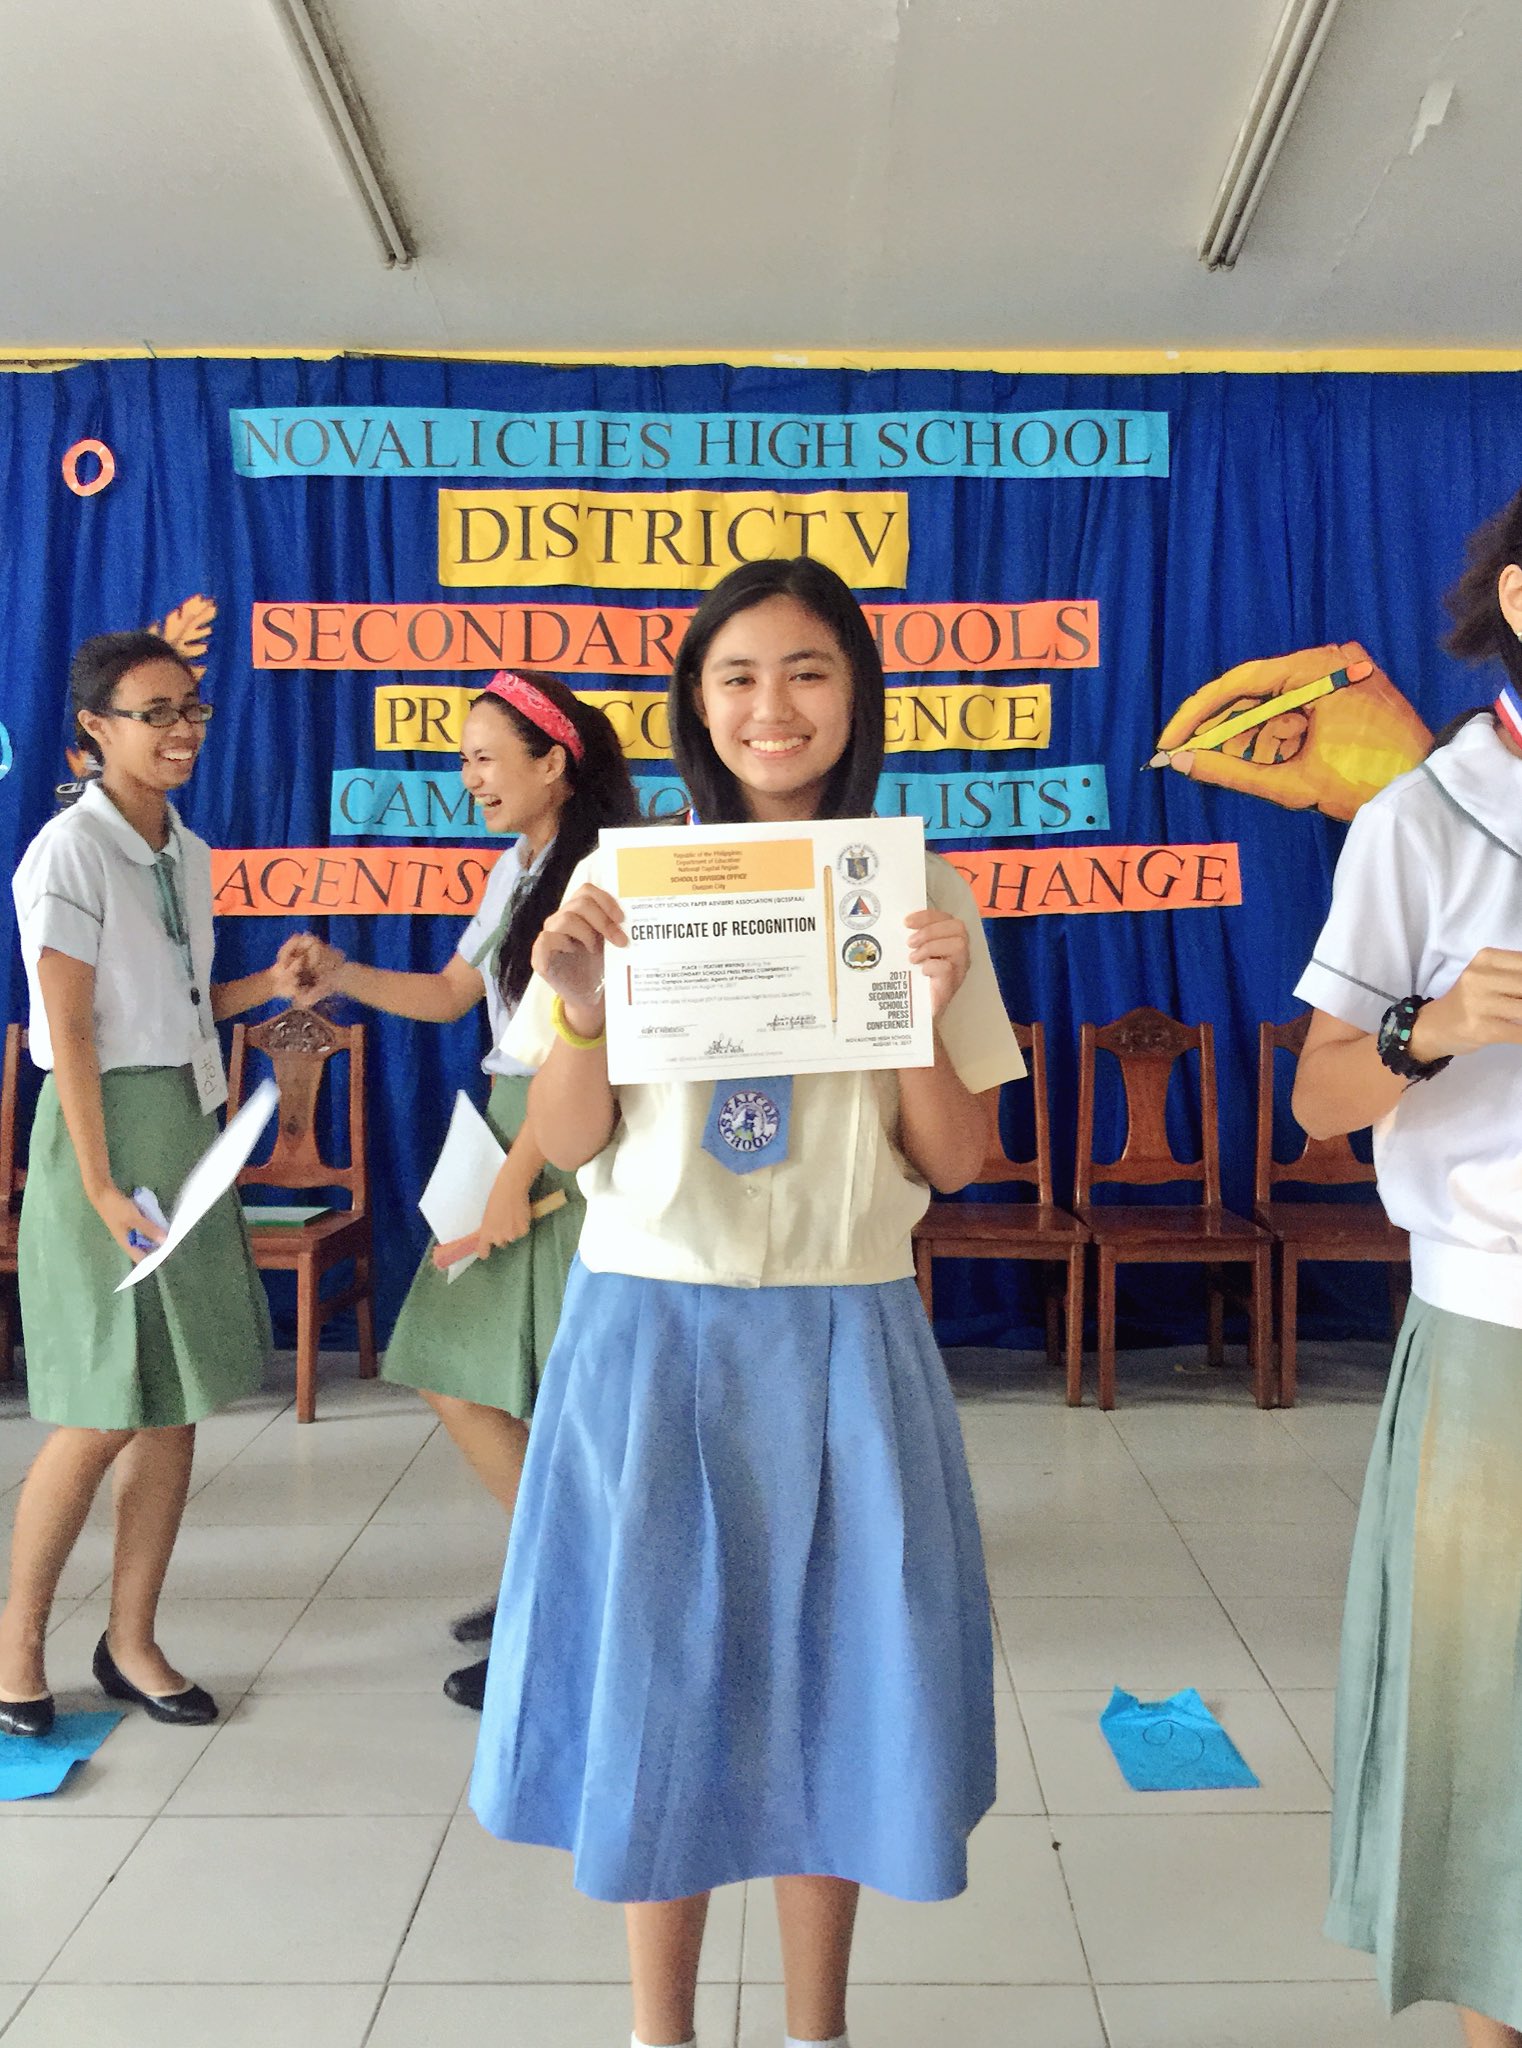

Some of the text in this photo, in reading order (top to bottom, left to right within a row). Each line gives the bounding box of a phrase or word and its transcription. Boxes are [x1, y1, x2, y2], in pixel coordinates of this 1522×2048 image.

[240, 417, 1152, 469] NOVALICHES HIGH SCHOOL
[453, 502, 898, 567] DISTRICT V
[262, 607, 695, 667] SECONDAR
[339, 777, 478, 827] CAM
[214, 849, 1228, 912] AGENTS HANGE
[631, 916, 816, 940] CERTIFICATE OF RECOGNITION
[872, 981, 908, 991] DISTRICT 5
[890, 971, 907, 980] 2017
[868, 991, 908, 1001] SECONDARY
[878, 1001, 908, 1010] SCHOOLS
[866, 1020, 909, 1030] CONFERENCE
[888, 1010, 909, 1019] PRESS
[722, 1093, 778, 1125] FALCON
[721, 1118, 773, 1151] SCHOOL
